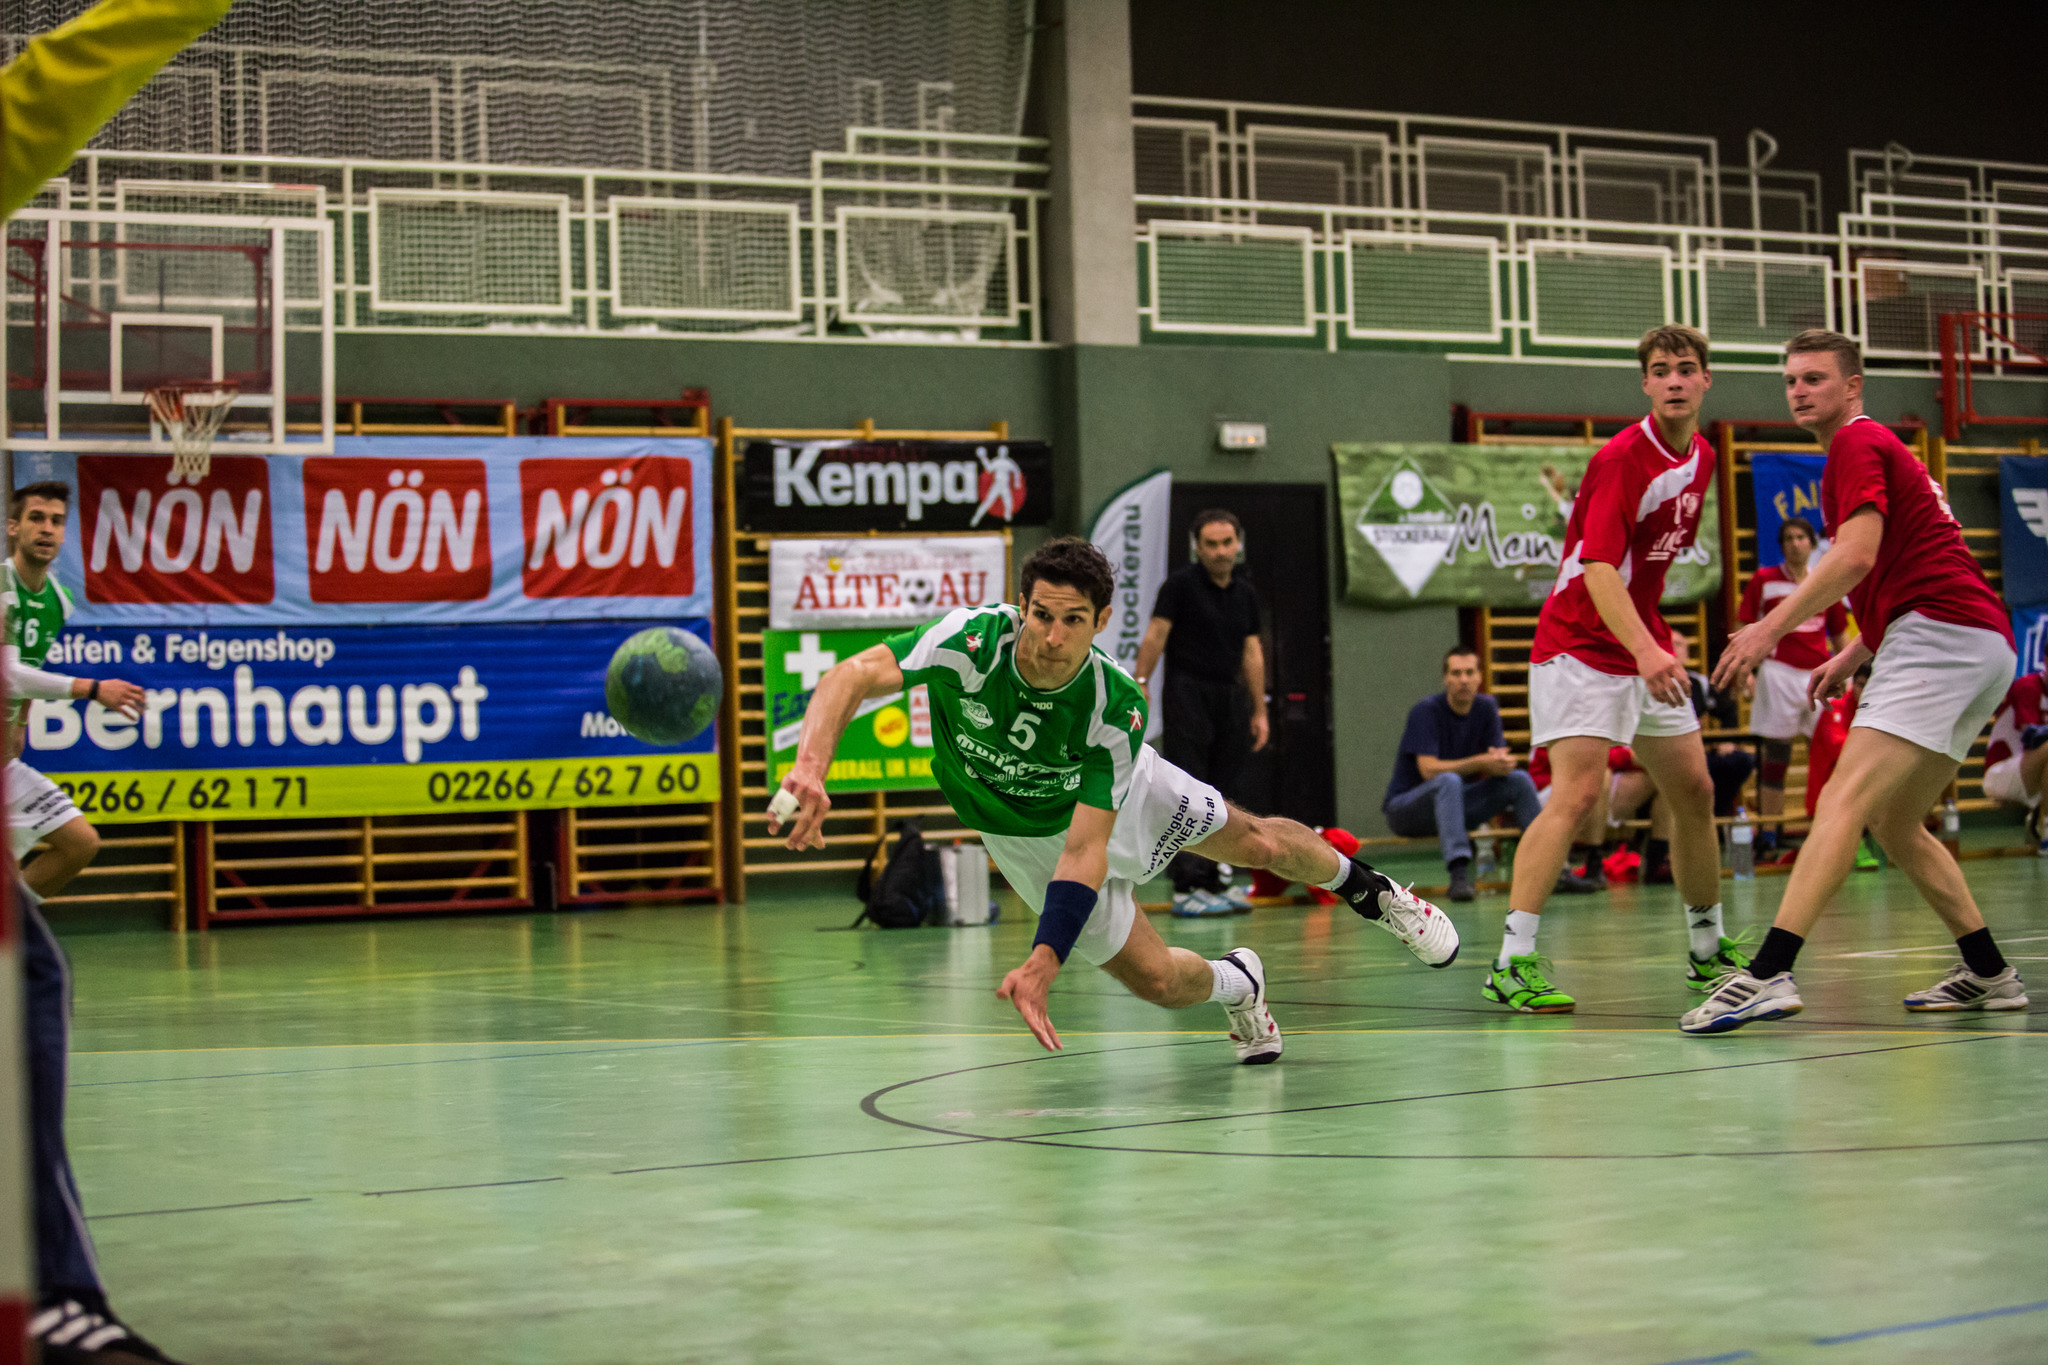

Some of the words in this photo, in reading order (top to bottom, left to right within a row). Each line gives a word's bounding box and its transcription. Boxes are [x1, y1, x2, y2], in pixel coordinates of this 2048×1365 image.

[773, 447, 979, 521] Kempa
[90, 469, 262, 574] NÖN
[315, 469, 482, 574] NÖN
[529, 467, 687, 570] NÖN
[1444, 502, 1562, 568] Mein
[793, 573, 901, 610] ALTE
[936, 571, 988, 607] AU
[1116, 504, 1142, 661] Stockerau
[24, 618, 41, 648] 6
[46, 633, 123, 664] eifen
[131, 633, 157, 664] &
[165, 632, 336, 668] Felgenshop
[27, 664, 489, 764] Bernhaupt
[1007, 712, 1042, 751] 5
[188, 777, 231, 810] 62
[271, 775, 309, 807] 71
[428, 768, 534, 803] 02266
[574, 766, 614, 798] 62
[625, 765, 644, 795] 7
[657, 763, 700, 793] 60
